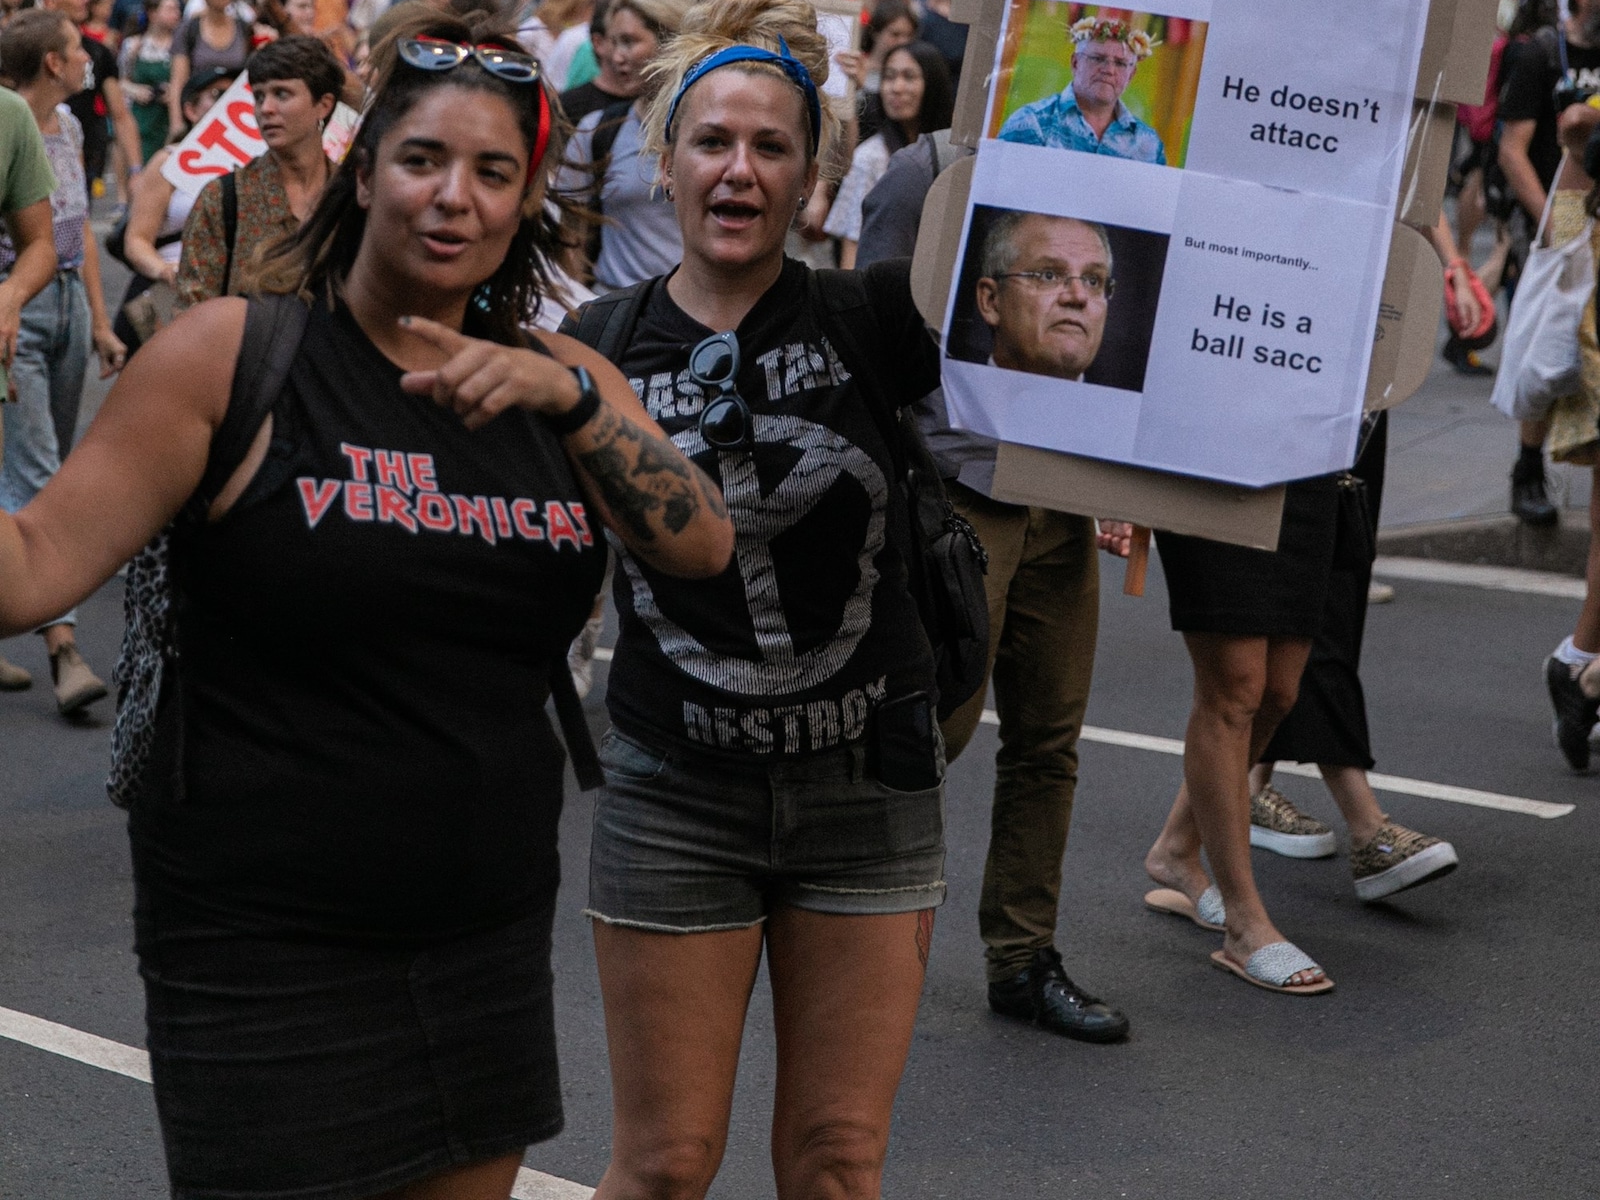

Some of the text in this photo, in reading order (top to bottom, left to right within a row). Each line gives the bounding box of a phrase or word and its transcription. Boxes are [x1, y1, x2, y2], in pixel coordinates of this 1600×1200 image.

[1222, 75, 1380, 123] He doesn't
[178, 83, 265, 176] STO
[1250, 122, 1339, 153] attacc
[1184, 236, 1319, 271] But most importantly...
[1213, 294, 1312, 334] He is a
[1191, 328, 1322, 374] ball sacc
[341, 442, 439, 496] THE
[297, 477, 595, 552] VERONICAS
